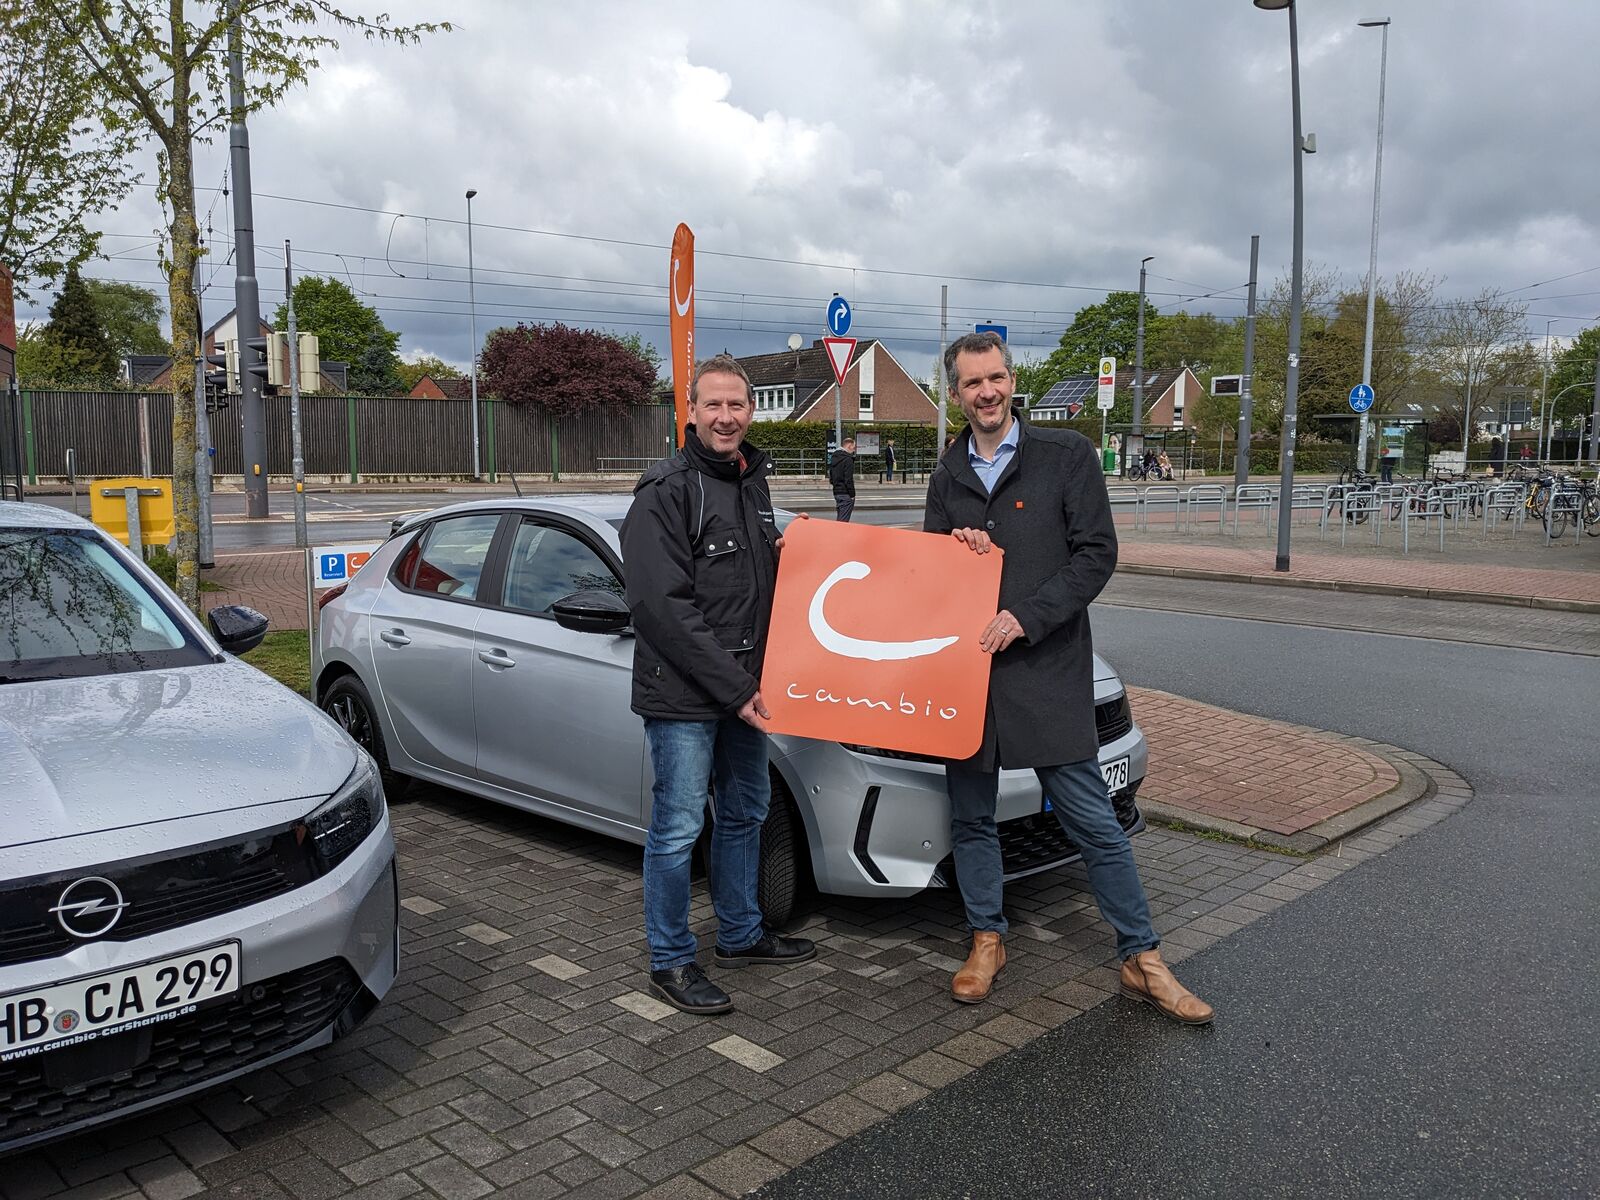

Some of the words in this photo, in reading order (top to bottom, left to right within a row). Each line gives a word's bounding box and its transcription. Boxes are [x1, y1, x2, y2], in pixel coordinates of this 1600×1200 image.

[328, 557, 338, 572] P
[787, 683, 957, 719] cambio
[1106, 762, 1126, 788] 278
[85, 976, 144, 1024] CA
[156, 953, 232, 1008] 299
